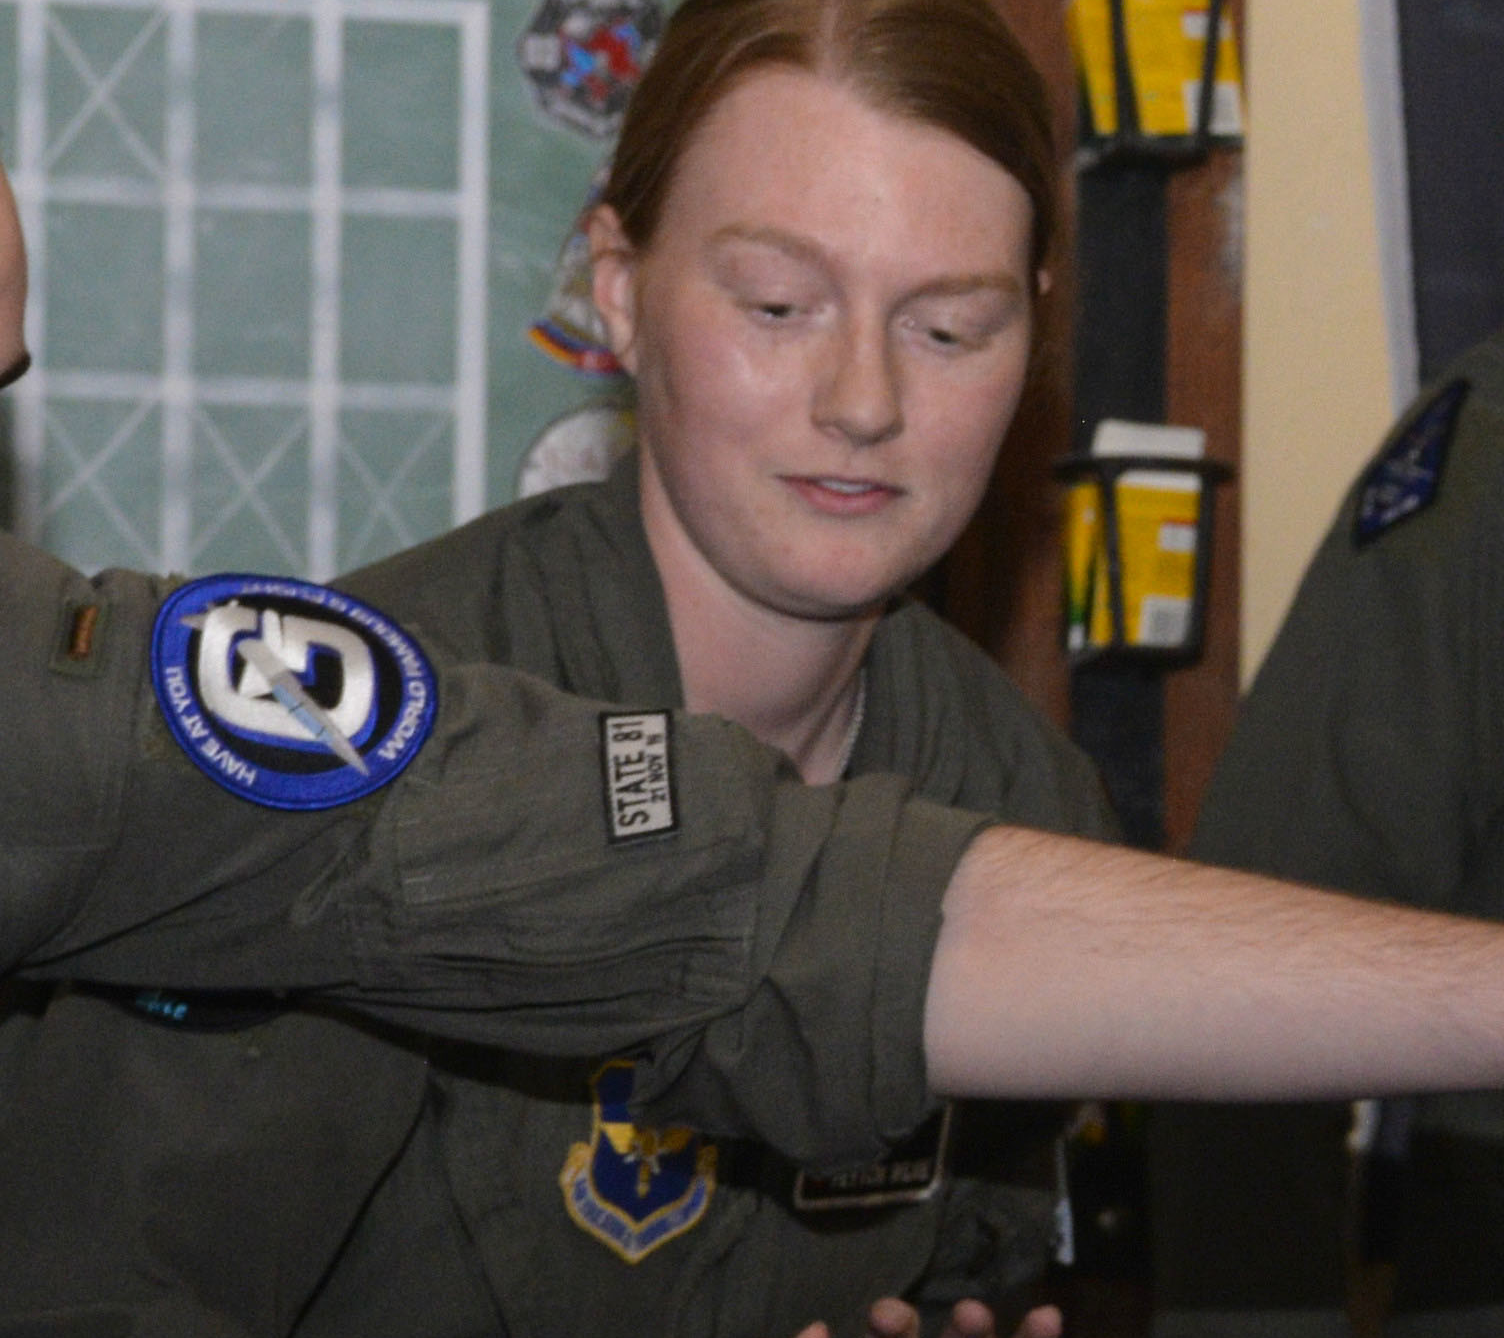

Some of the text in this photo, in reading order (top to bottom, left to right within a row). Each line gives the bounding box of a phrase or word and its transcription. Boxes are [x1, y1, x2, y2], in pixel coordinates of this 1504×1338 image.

[164, 665, 257, 788] HAVE AT YOU
[376, 679, 428, 760] WORLD
[611, 720, 651, 828] STATE 81
